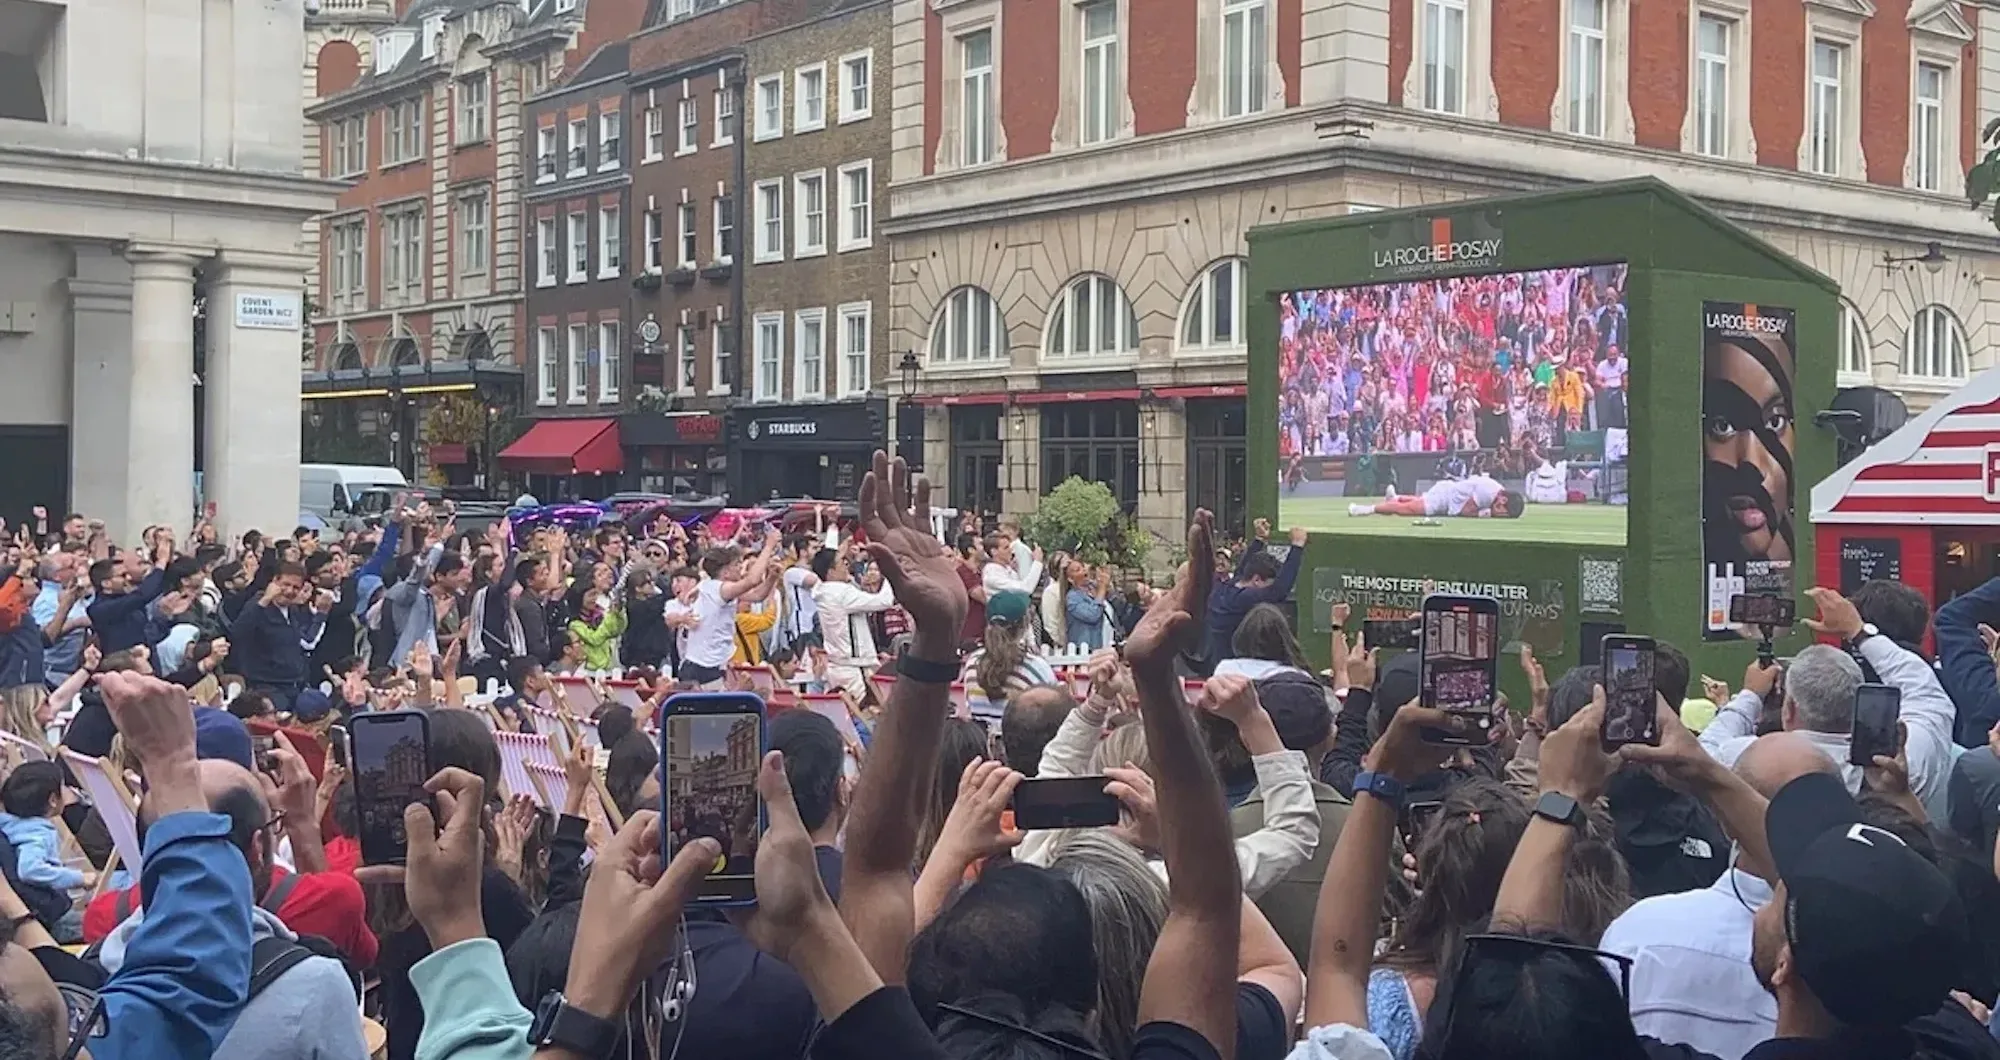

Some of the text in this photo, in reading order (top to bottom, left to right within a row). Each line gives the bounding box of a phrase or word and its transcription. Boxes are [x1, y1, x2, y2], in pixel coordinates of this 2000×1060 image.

[1374, 239, 1501, 267] LA ROCHE POSAY
[242, 297, 272, 306] COVENT
[242, 307, 273, 316] GARDEN
[1706, 313, 1787, 333] LA ROCHE POSAY
[768, 422, 816, 434] STARBUCKS
[1341, 575, 1364, 589] THE
[1367, 577, 1398, 591] MOST
[1464, 582, 1480, 595] UV
[1483, 583, 1528, 599] FILTER
[1361, 591, 1385, 606] THE
[1386, 593, 1420, 609] MOST
